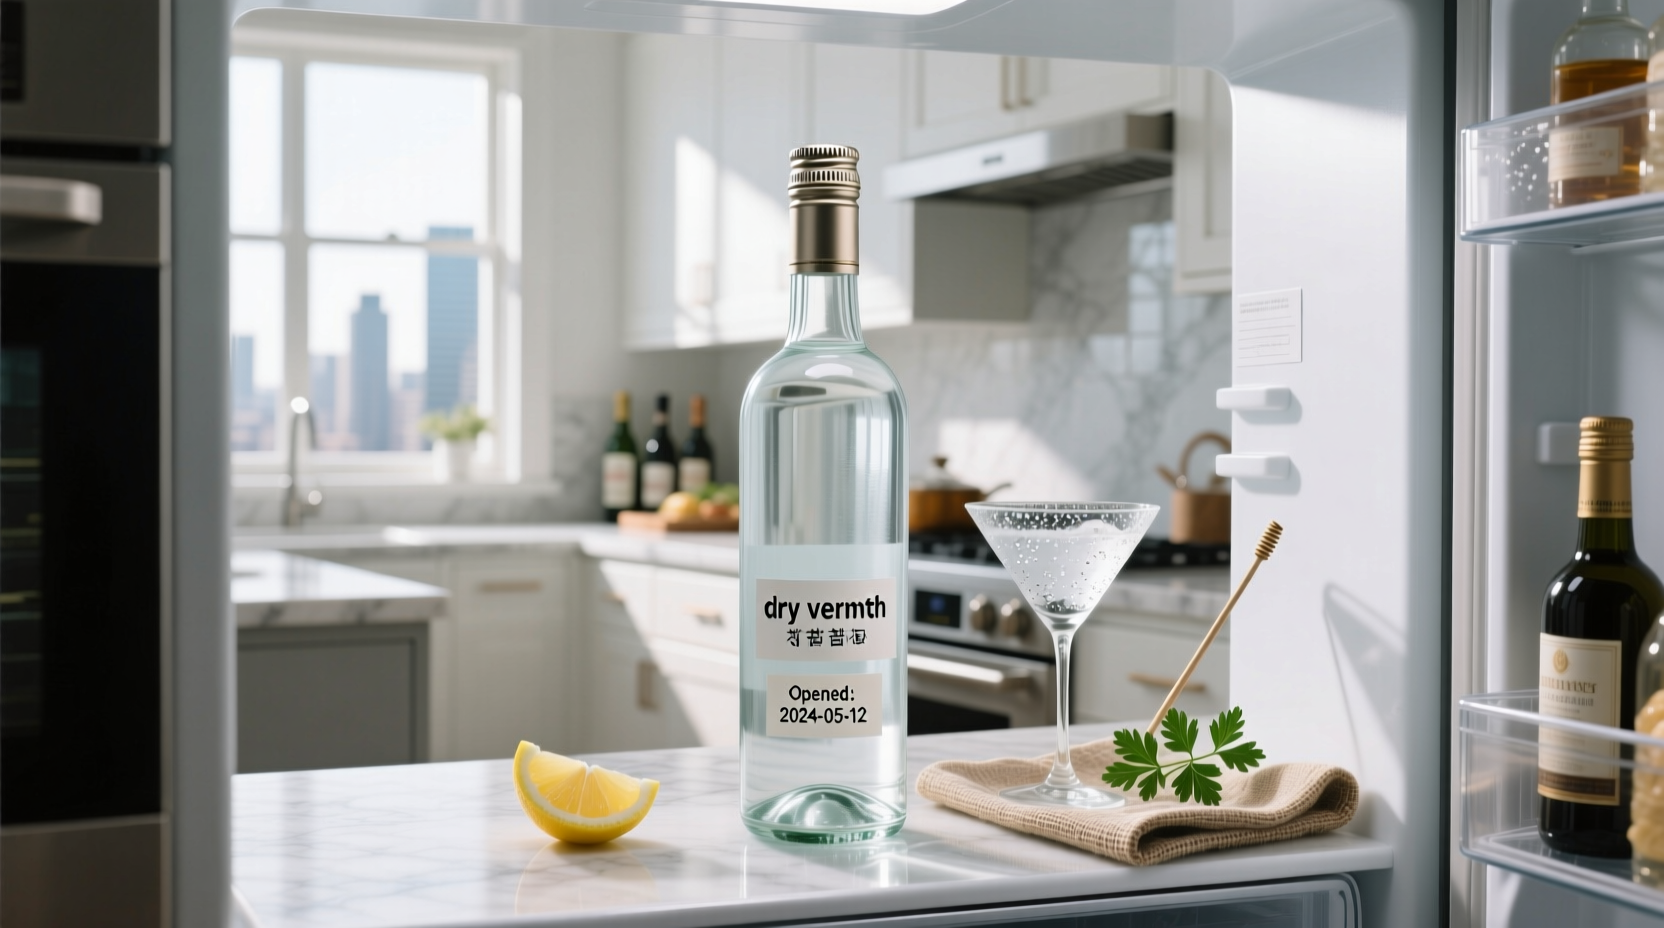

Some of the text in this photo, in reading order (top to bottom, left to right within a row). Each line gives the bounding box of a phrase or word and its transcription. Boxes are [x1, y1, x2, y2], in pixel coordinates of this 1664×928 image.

[764, 594, 886, 625] dry vermth
[788, 685, 855, 705] Opened:
[779, 706, 868, 724] 2024-05-12
